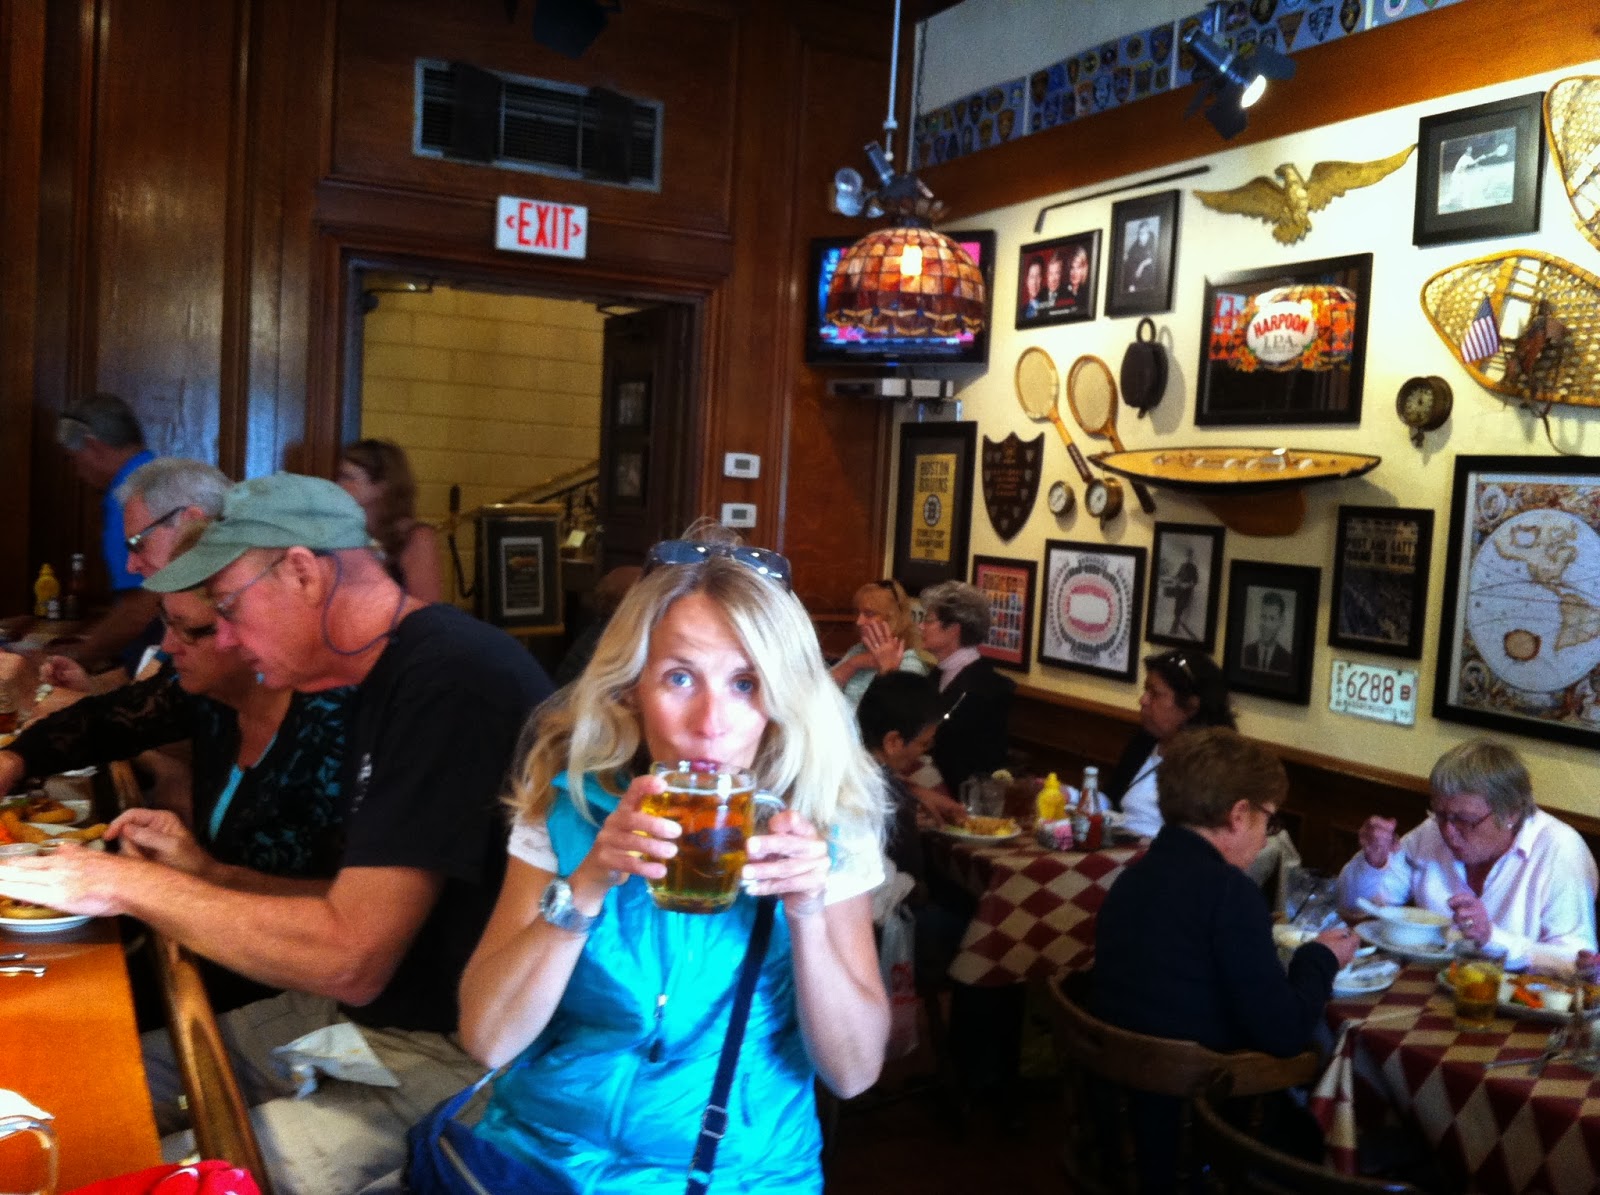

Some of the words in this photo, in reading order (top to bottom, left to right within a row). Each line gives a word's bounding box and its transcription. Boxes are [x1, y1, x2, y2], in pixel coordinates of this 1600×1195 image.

[517, 201, 575, 251] EXIT
[1253, 313, 1310, 338] HARPOON
[1346, 670, 1395, 705] 6288
